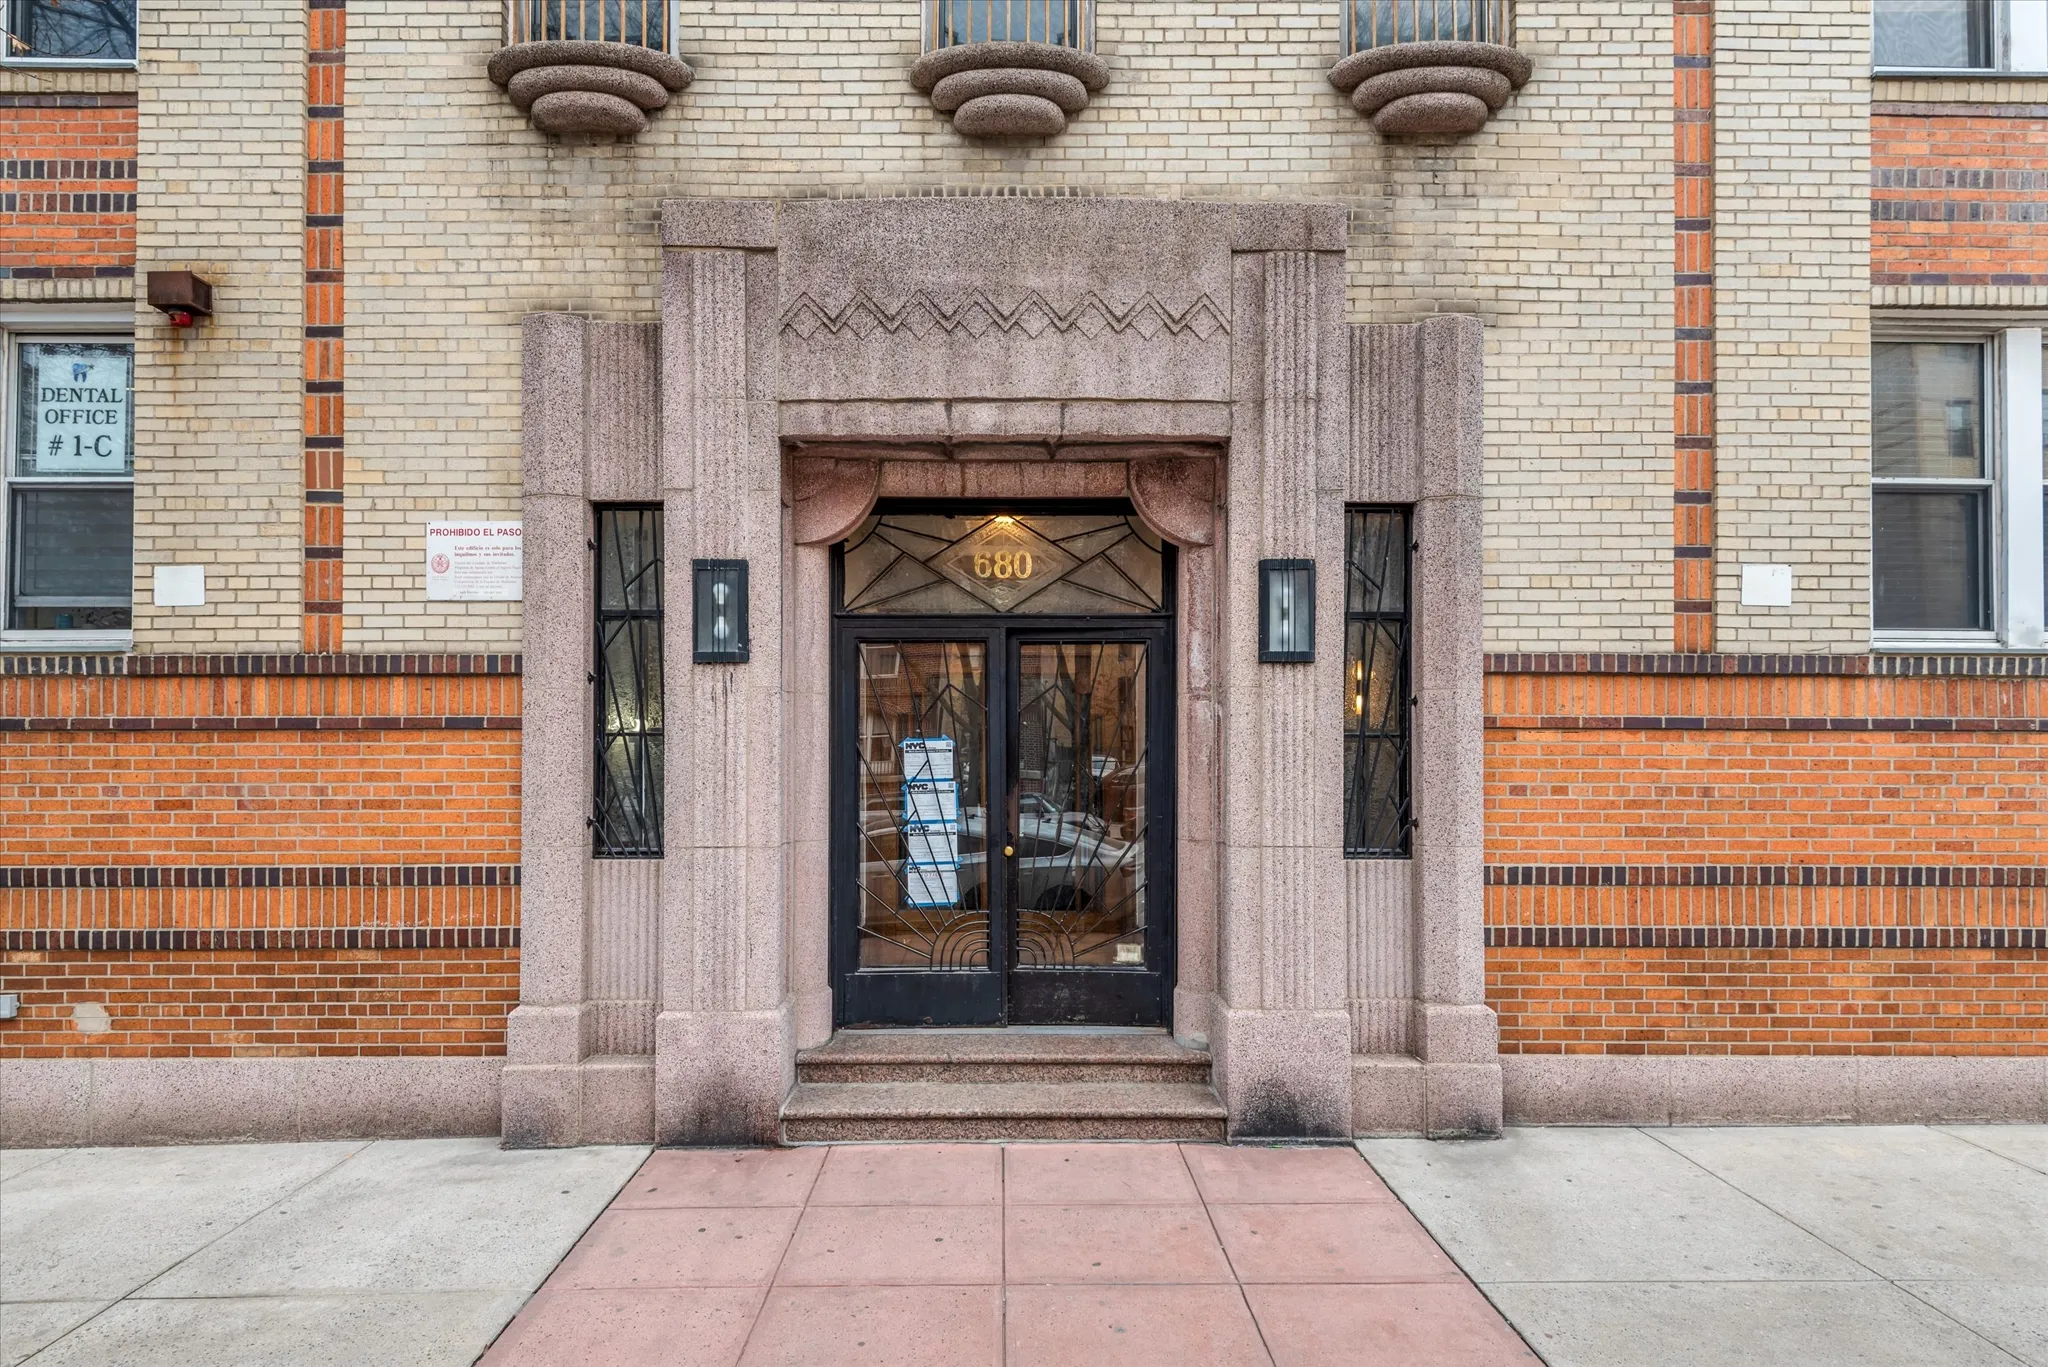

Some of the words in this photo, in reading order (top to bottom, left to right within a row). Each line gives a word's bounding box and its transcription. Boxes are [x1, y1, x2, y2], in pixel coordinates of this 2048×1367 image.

[40, 387, 123, 403] DENTAL
[44, 408, 118, 425] OFFICE
[48, 434, 64, 456] #
[73, 434, 112, 457] 1-C
[429, 528, 481, 537] PROHIBIDO
[483, 528, 494, 537] EL
[497, 528, 522, 537] PASO
[973, 550, 1033, 579] 680
[905, 742, 926, 750] NYC
[909, 783, 929, 791] NYC
[910, 824, 930, 833] NYC
